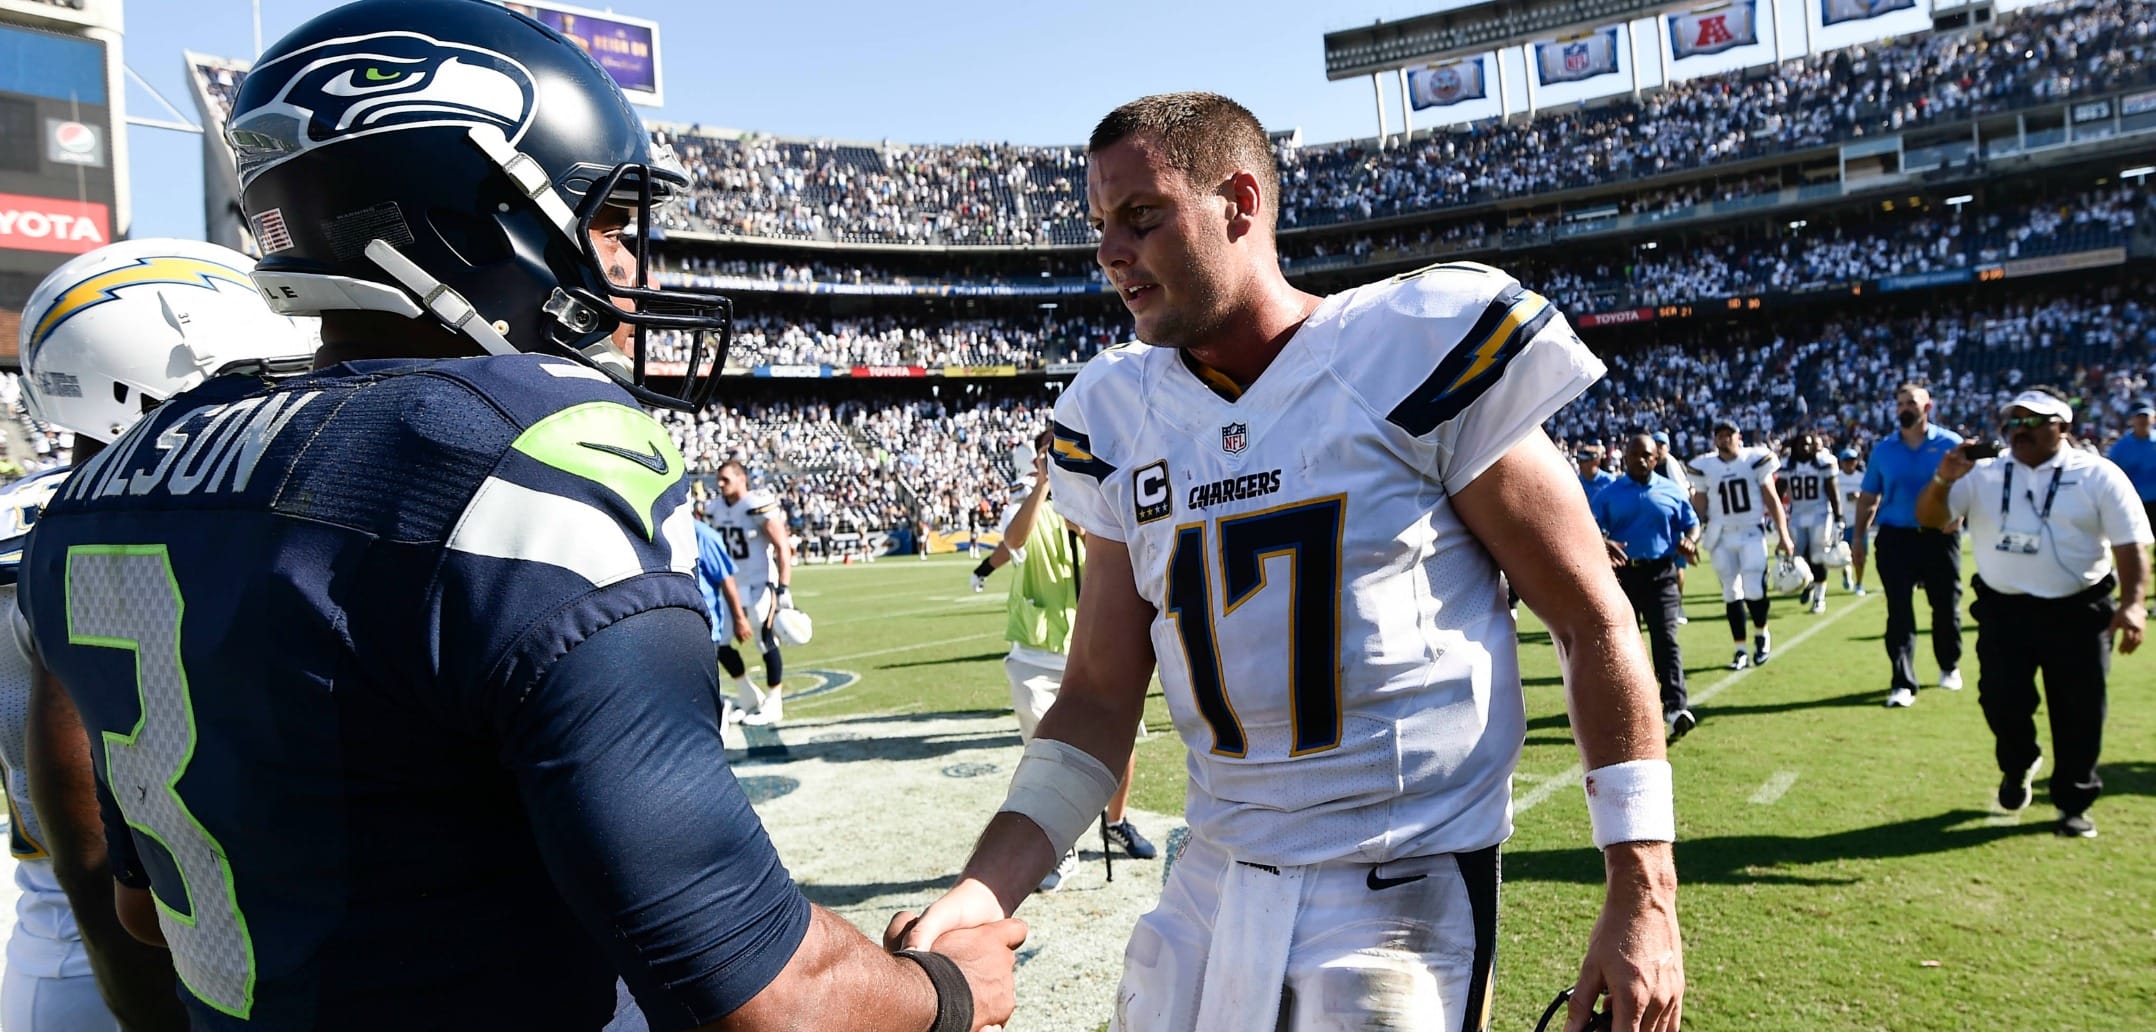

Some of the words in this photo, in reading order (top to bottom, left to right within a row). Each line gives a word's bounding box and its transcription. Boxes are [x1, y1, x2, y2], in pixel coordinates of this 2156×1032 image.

[1594, 311, 1639, 325] TOYOTA
[869, 367, 910, 377] TOYOTA
[64, 390, 325, 502] WILSON
[1225, 433, 1245, 451] NFL
[1136, 464, 1167, 507] C
[1187, 469, 1281, 510] CHARGERS
[1718, 478, 1751, 515] 10
[1790, 475, 1818, 500] 88
[1165, 492, 1347, 758] 17
[64, 544, 256, 1020] 3
